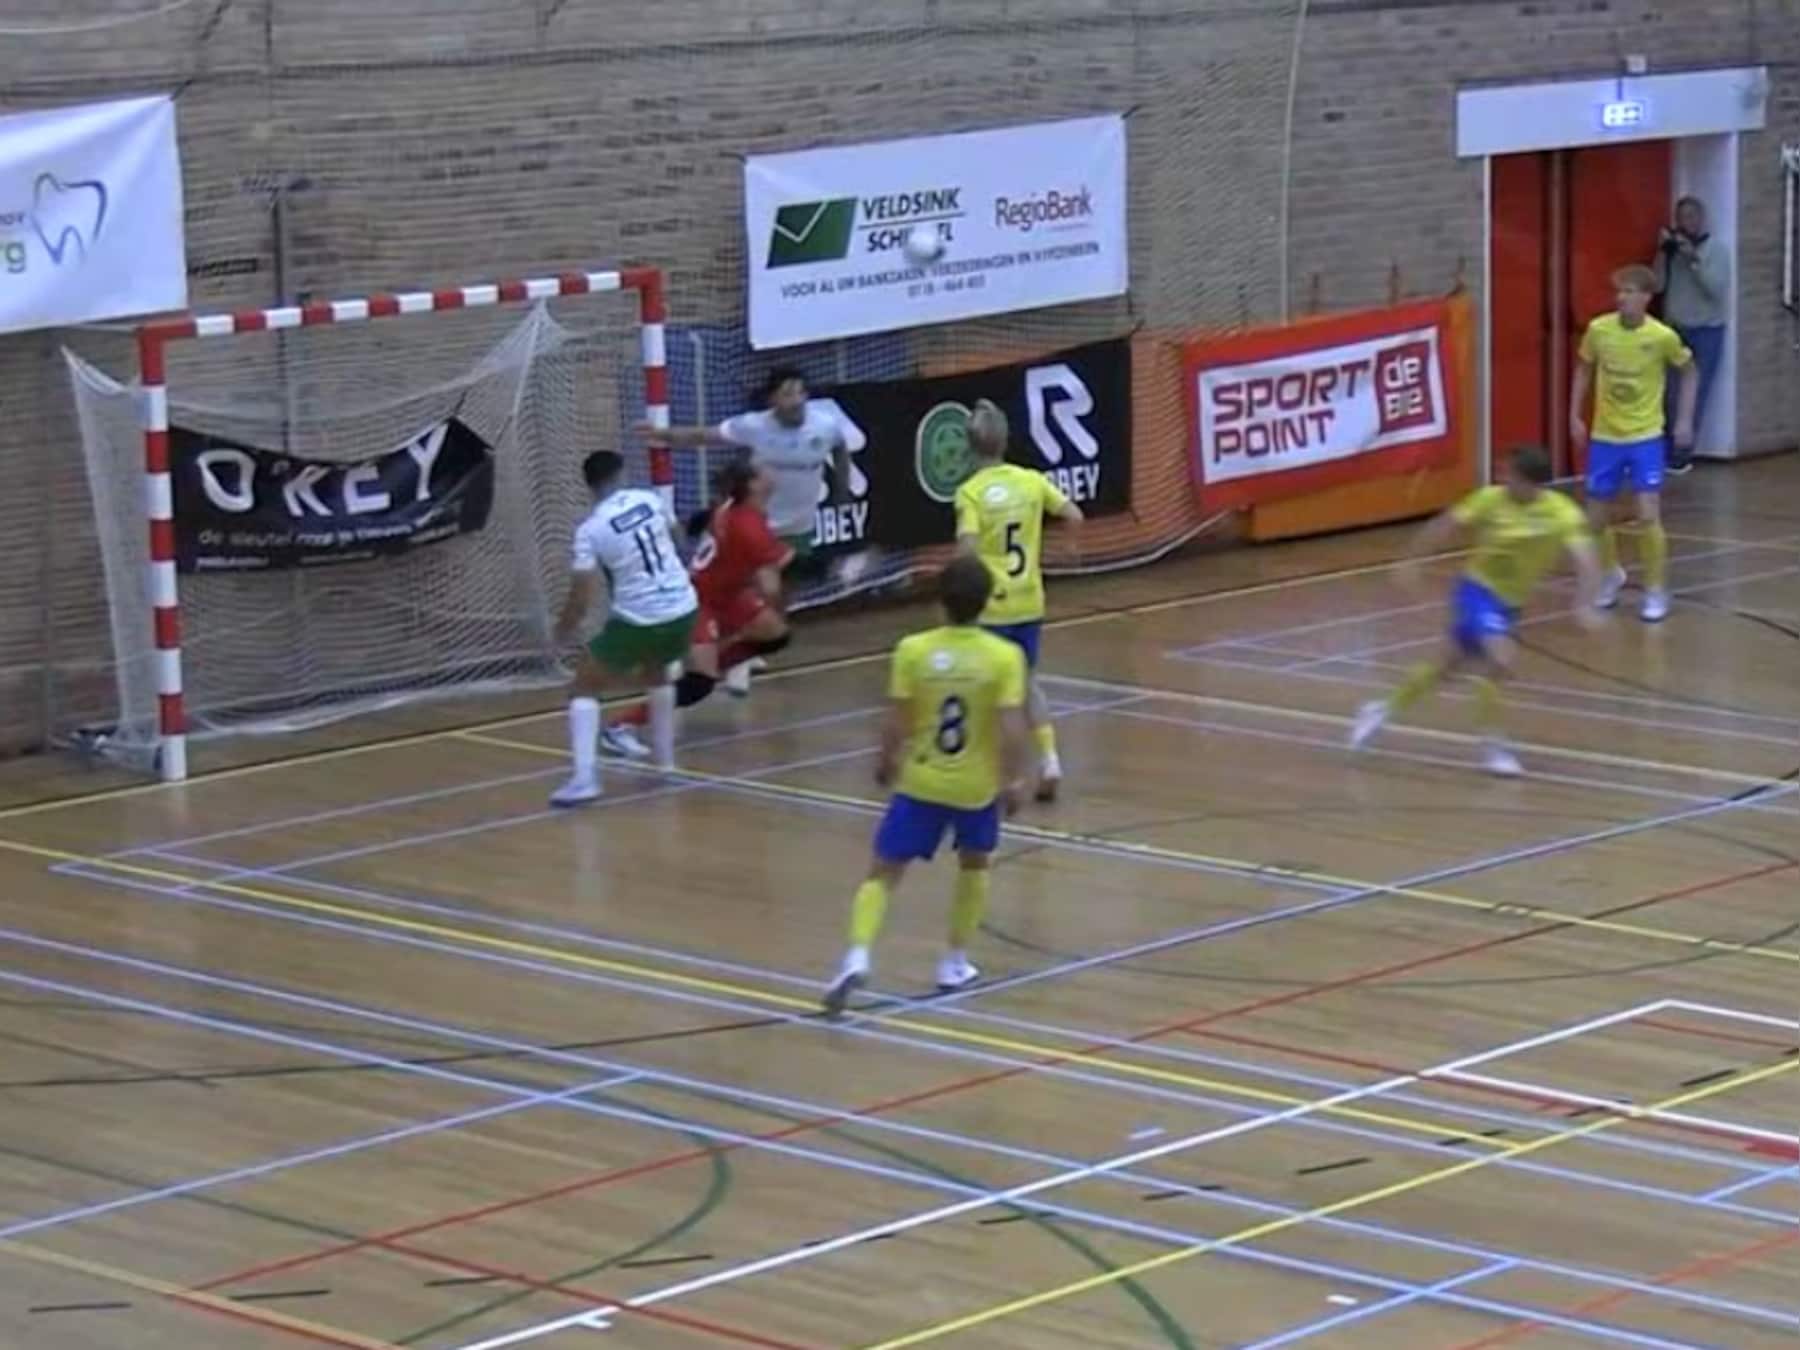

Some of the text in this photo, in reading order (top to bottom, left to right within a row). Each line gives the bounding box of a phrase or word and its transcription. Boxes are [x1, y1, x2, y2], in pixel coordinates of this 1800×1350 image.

[863, 187, 960, 221] VELDSINK
[995, 186, 1093, 231] RegioBank
[1212, 358, 1371, 425] SPORT
[1213, 409, 1335, 465] POINT
[635, 524, 665, 577] 11
[1005, 522, 1027, 578] 5
[936, 695, 968, 754] 8
